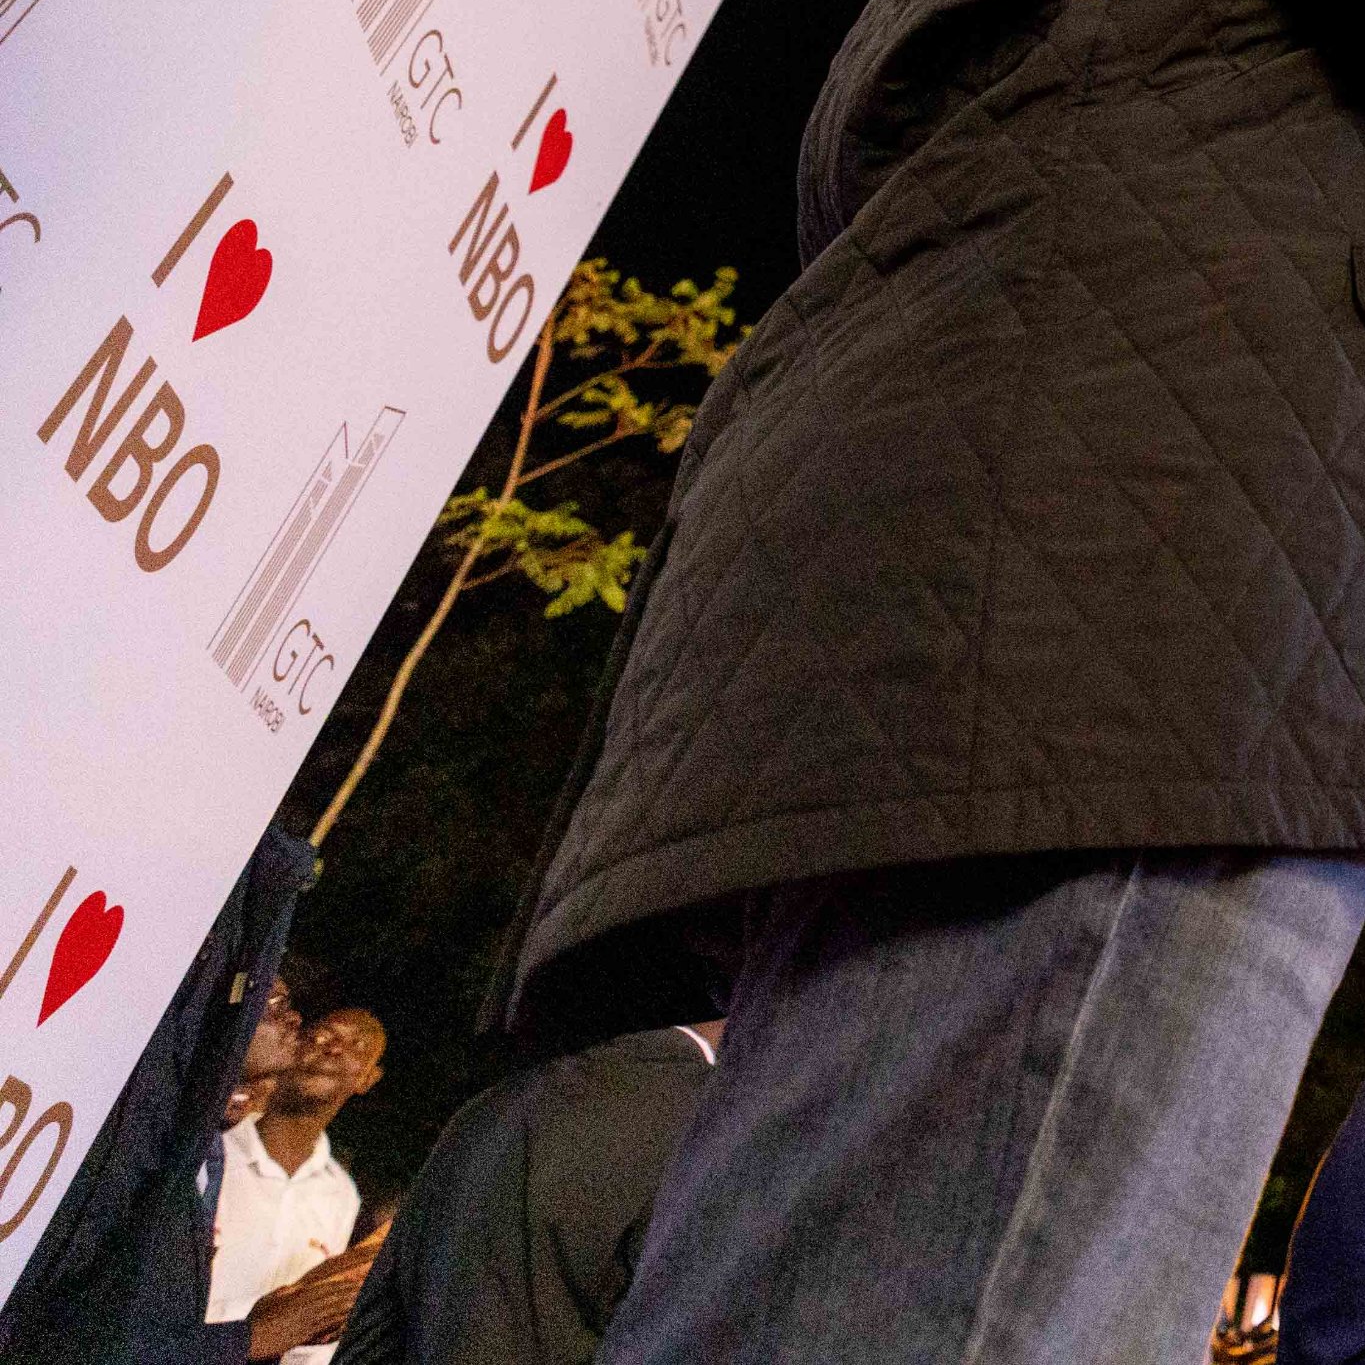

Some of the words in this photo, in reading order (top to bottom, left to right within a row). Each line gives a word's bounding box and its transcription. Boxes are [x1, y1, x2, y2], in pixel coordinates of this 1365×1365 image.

[408, 29, 463, 145] GTC
[511, 73, 558, 151] I
[151, 171, 235, 288] I
[448, 170, 535, 365] NBO
[36, 315, 221, 573] NBO
[273, 618, 335, 716] GTC
